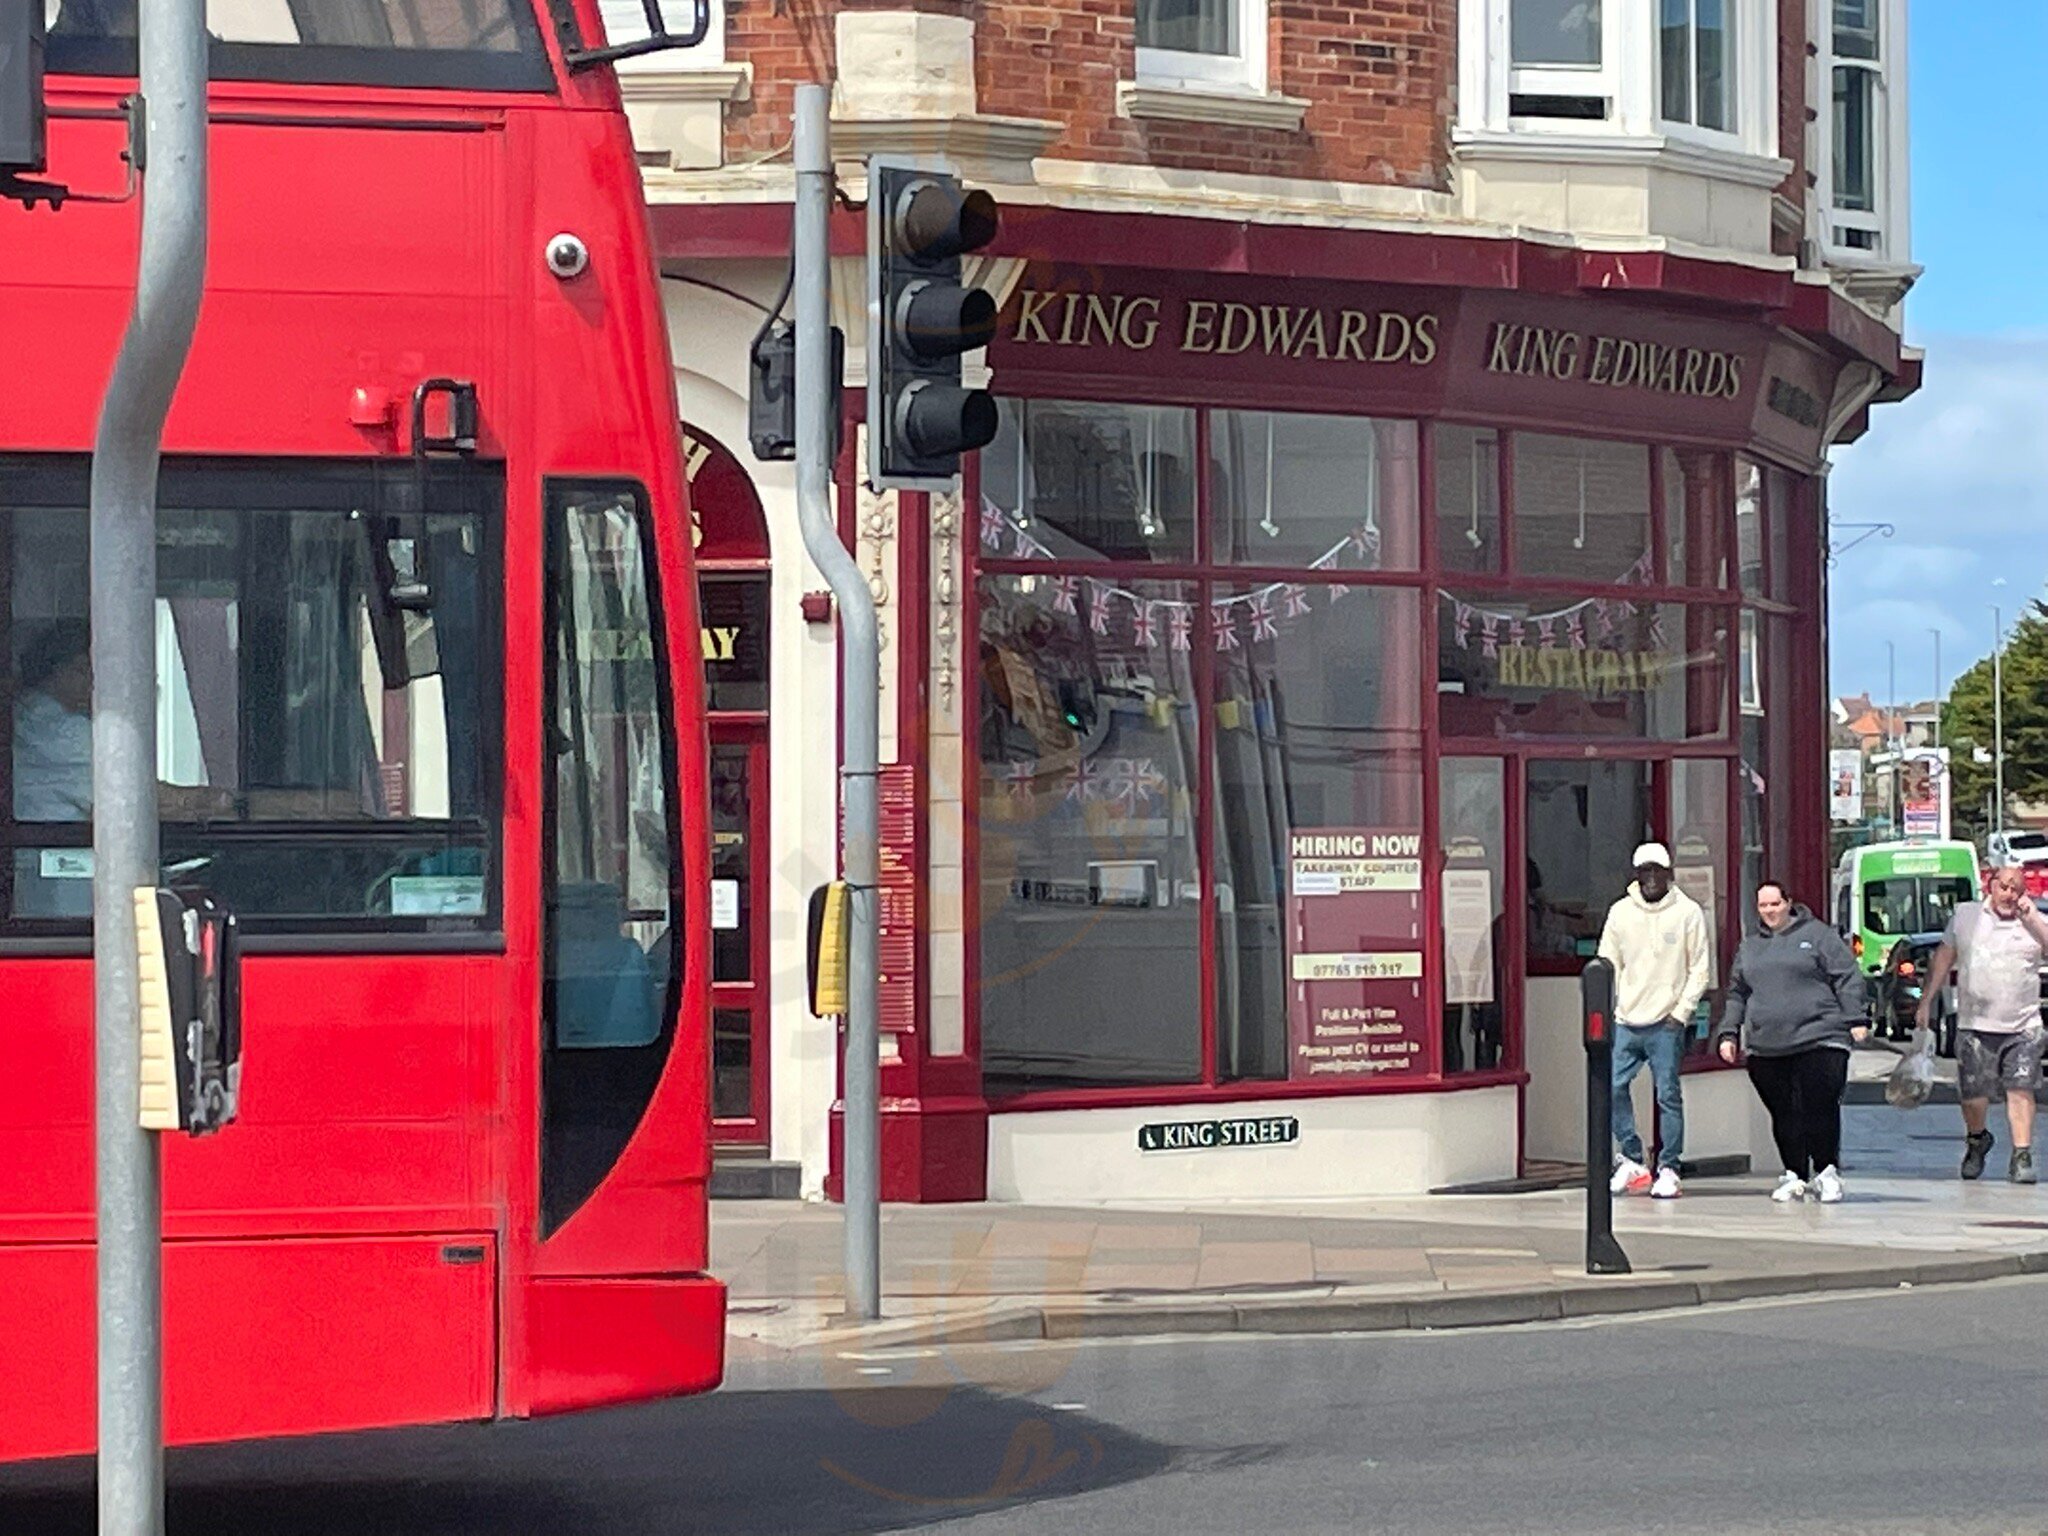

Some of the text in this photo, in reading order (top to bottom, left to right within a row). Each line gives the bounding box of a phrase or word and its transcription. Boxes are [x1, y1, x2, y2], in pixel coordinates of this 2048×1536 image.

[1011, 289, 1439, 365] KING EDWARDS
[1488, 322, 1746, 400] KING EDWARDS
[1292, 835, 1367, 857] HIRING
[1372, 834, 1421, 856] NOW
[1296, 862, 1360, 873] TAKEAWAY
[1340, 875, 1376, 888] STAFF
[1163, 1118, 1294, 1148] KING STREET
